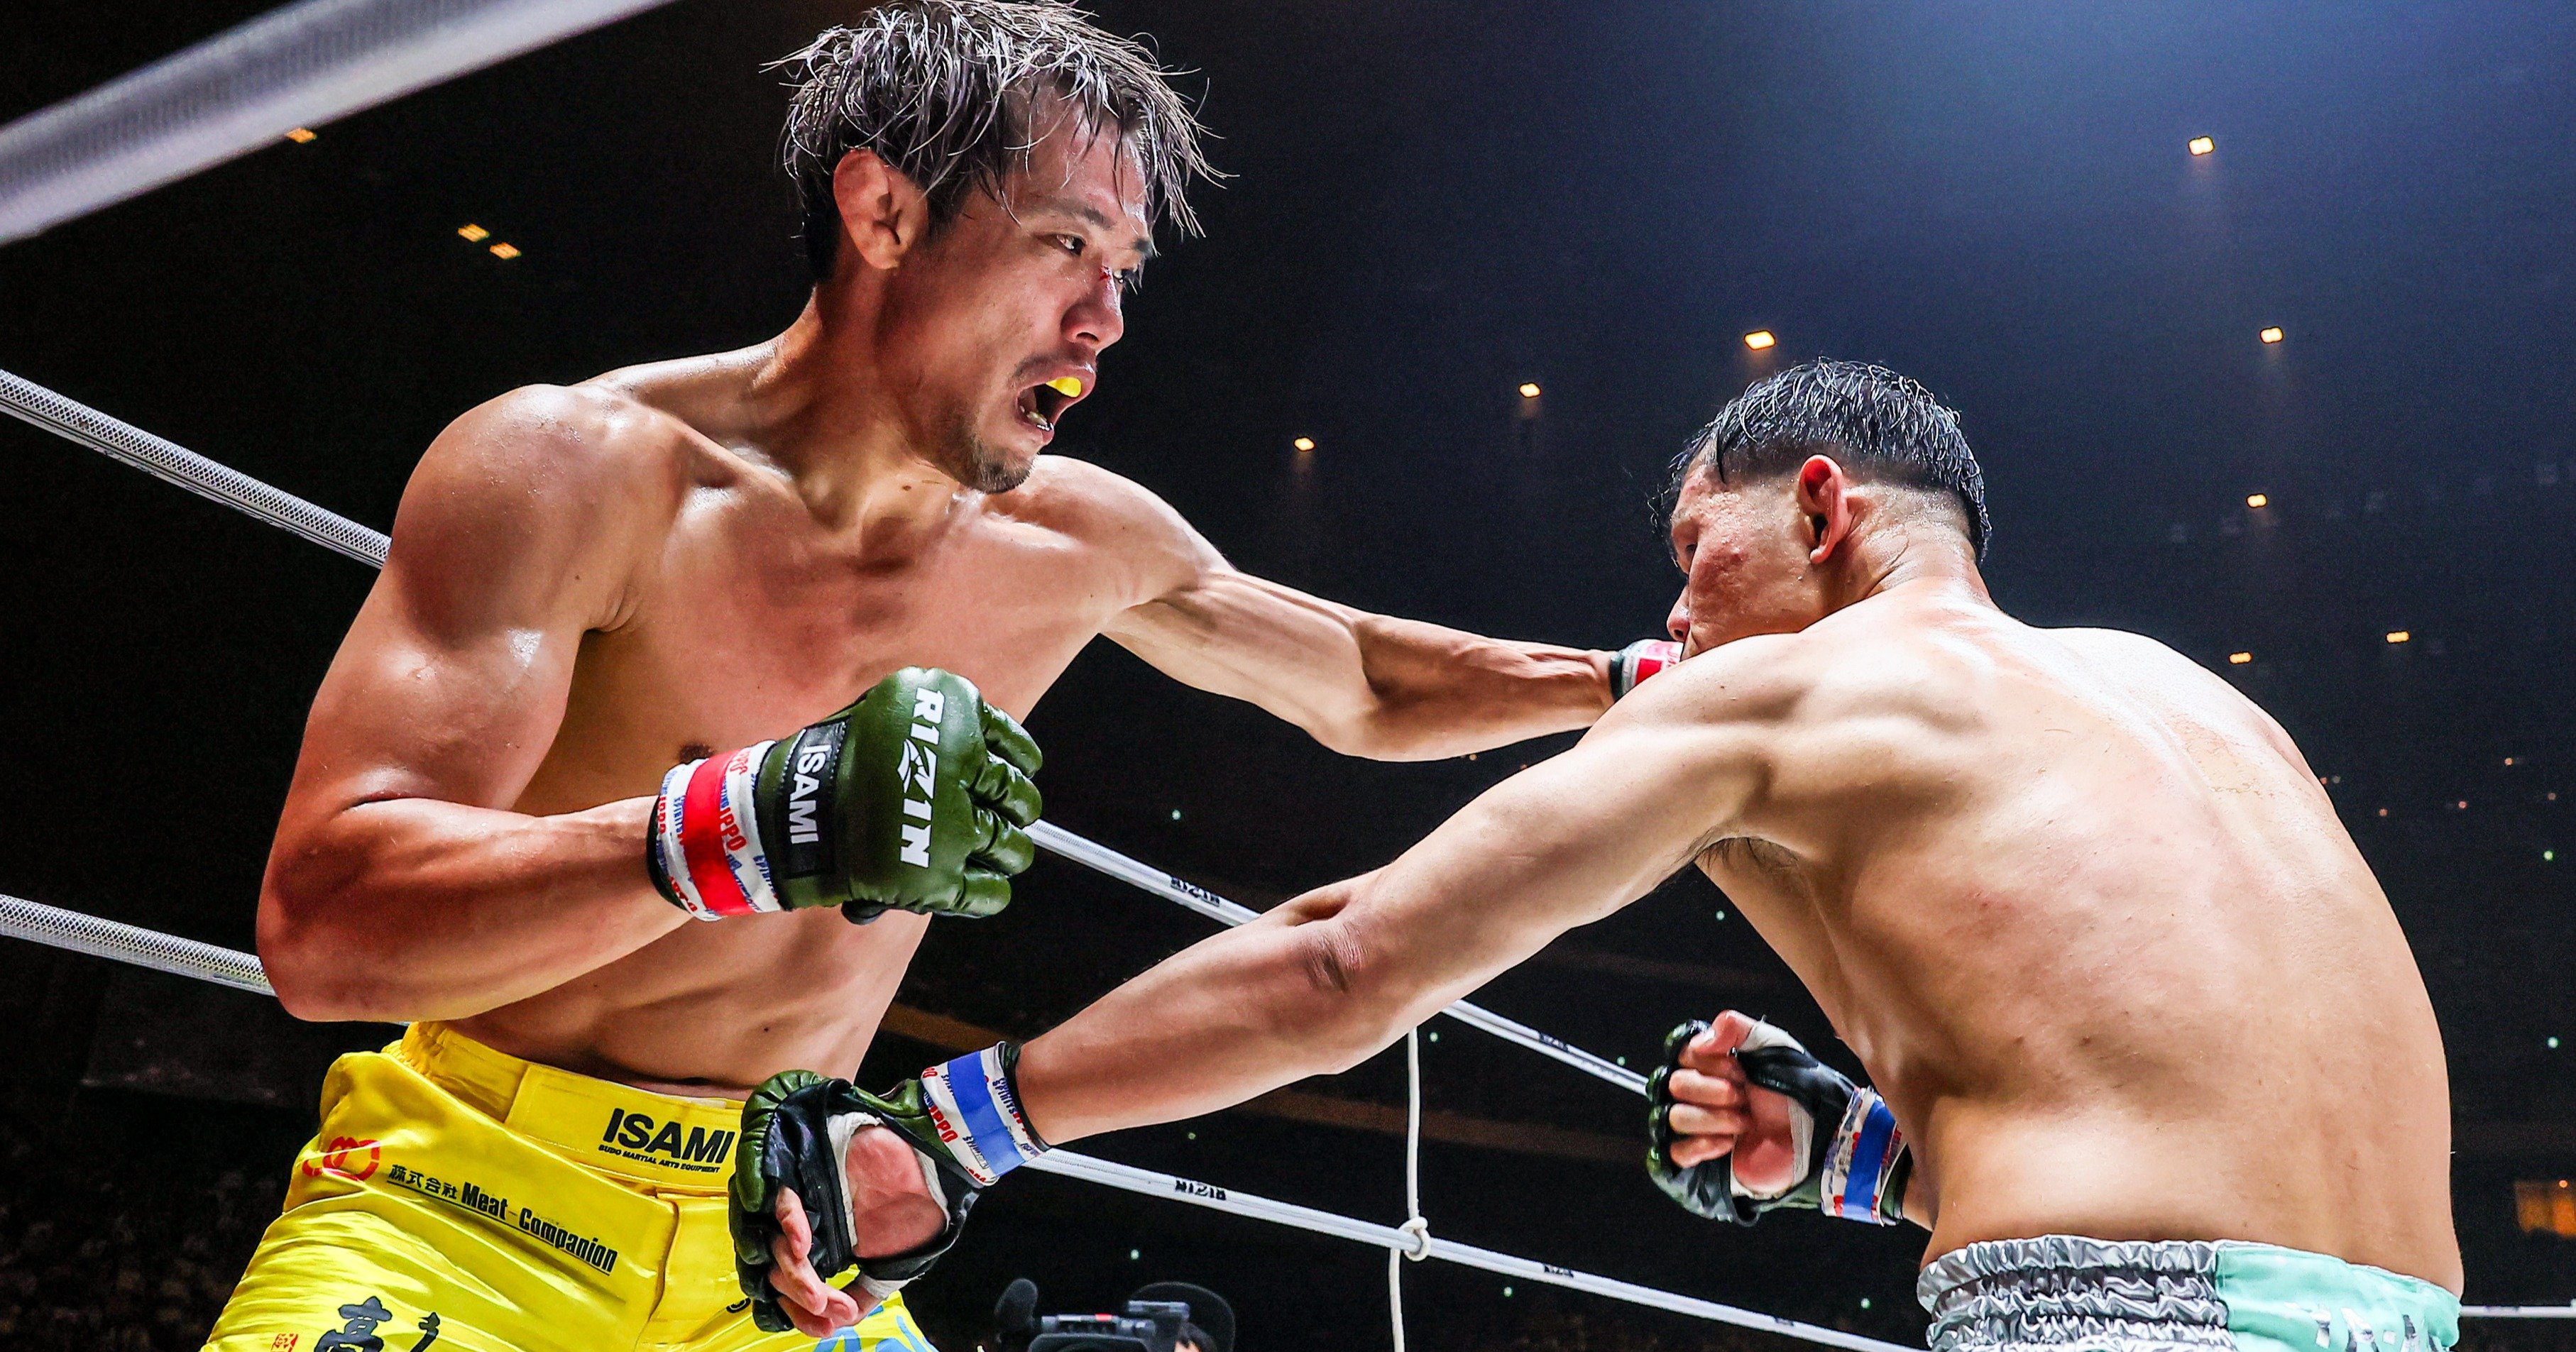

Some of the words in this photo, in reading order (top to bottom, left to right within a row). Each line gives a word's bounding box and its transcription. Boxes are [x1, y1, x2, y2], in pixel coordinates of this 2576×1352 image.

[789, 743, 828, 845] ISAMI
[719, 807, 747, 852] IPPO
[603, 1108, 735, 1164] ISAMI
[928, 1105, 958, 1143] IPPO
[598, 1144, 622, 1155] BUDO
[623, 1150, 657, 1164] MARTIAL
[659, 1159, 680, 1168] ARTS
[681, 1163, 720, 1173] EQUIPMENT
[388, 1164, 459, 1200] 株式会社
